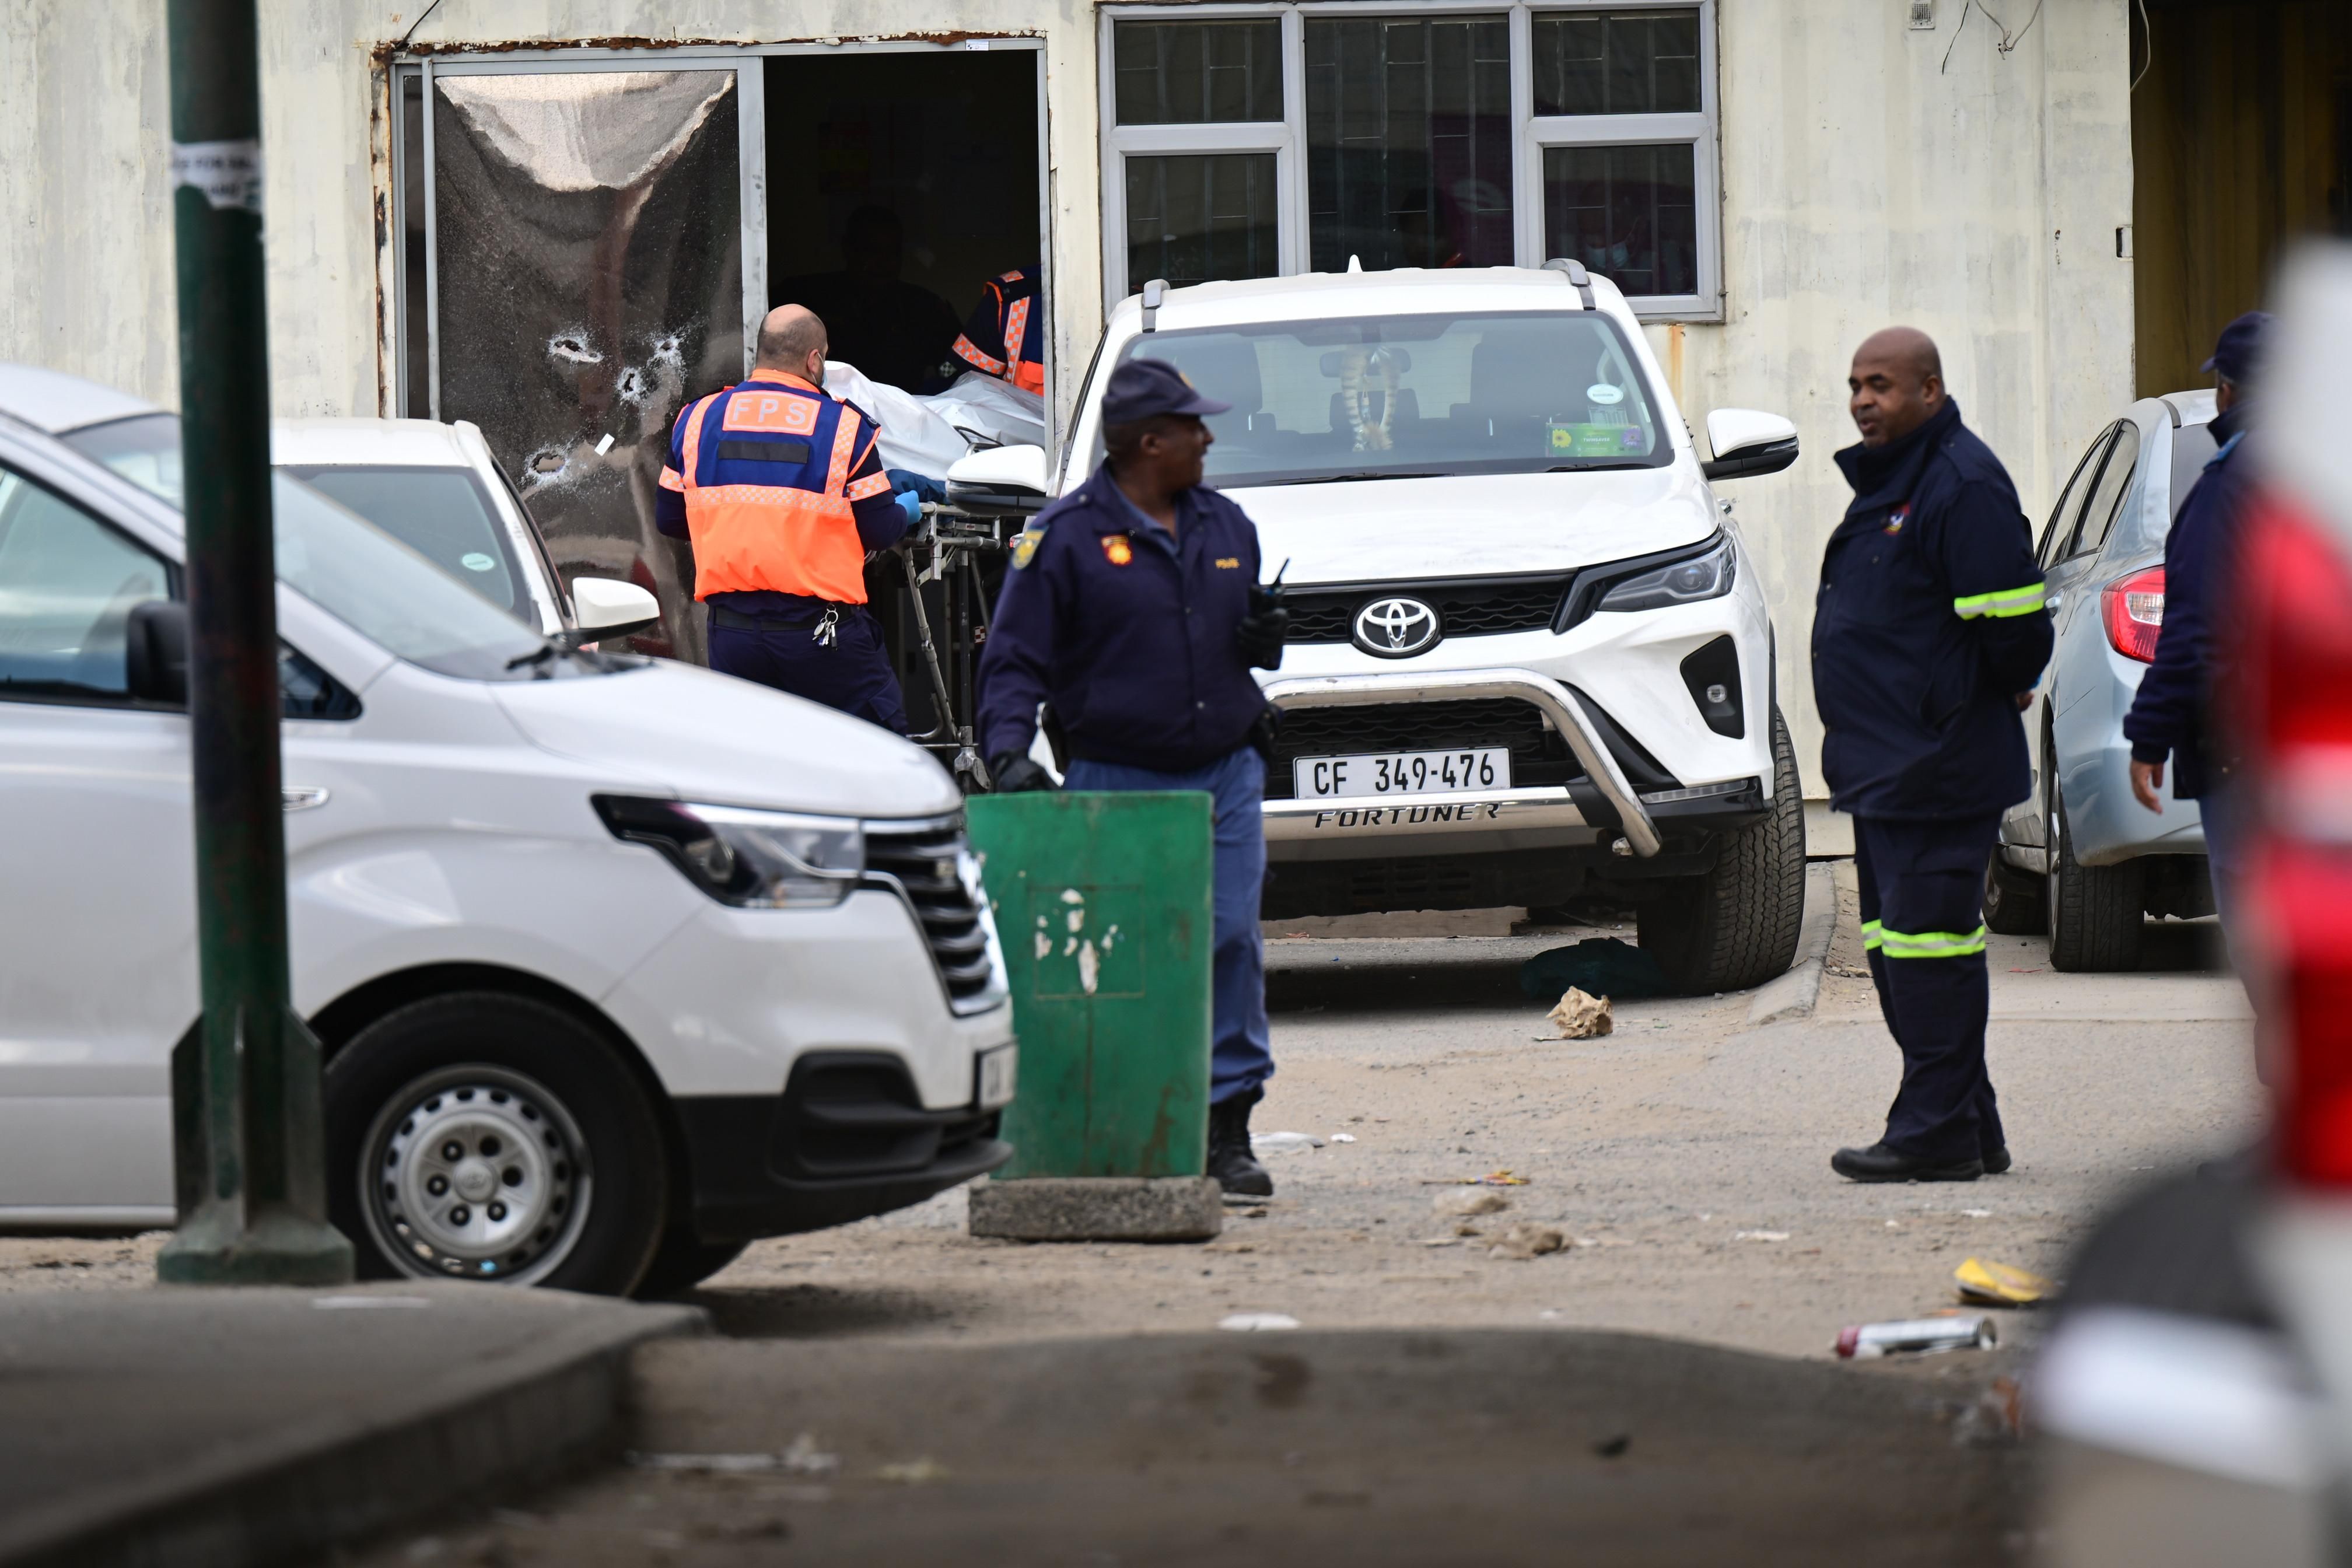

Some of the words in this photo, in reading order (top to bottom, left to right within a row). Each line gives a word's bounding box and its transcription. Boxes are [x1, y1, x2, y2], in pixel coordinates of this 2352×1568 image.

[733, 399, 807, 425] FPS
[1314, 762, 1348, 794] CF
[1375, 753, 1494, 792] 349-476
[1315, 803, 1500, 828] FORTUNER
